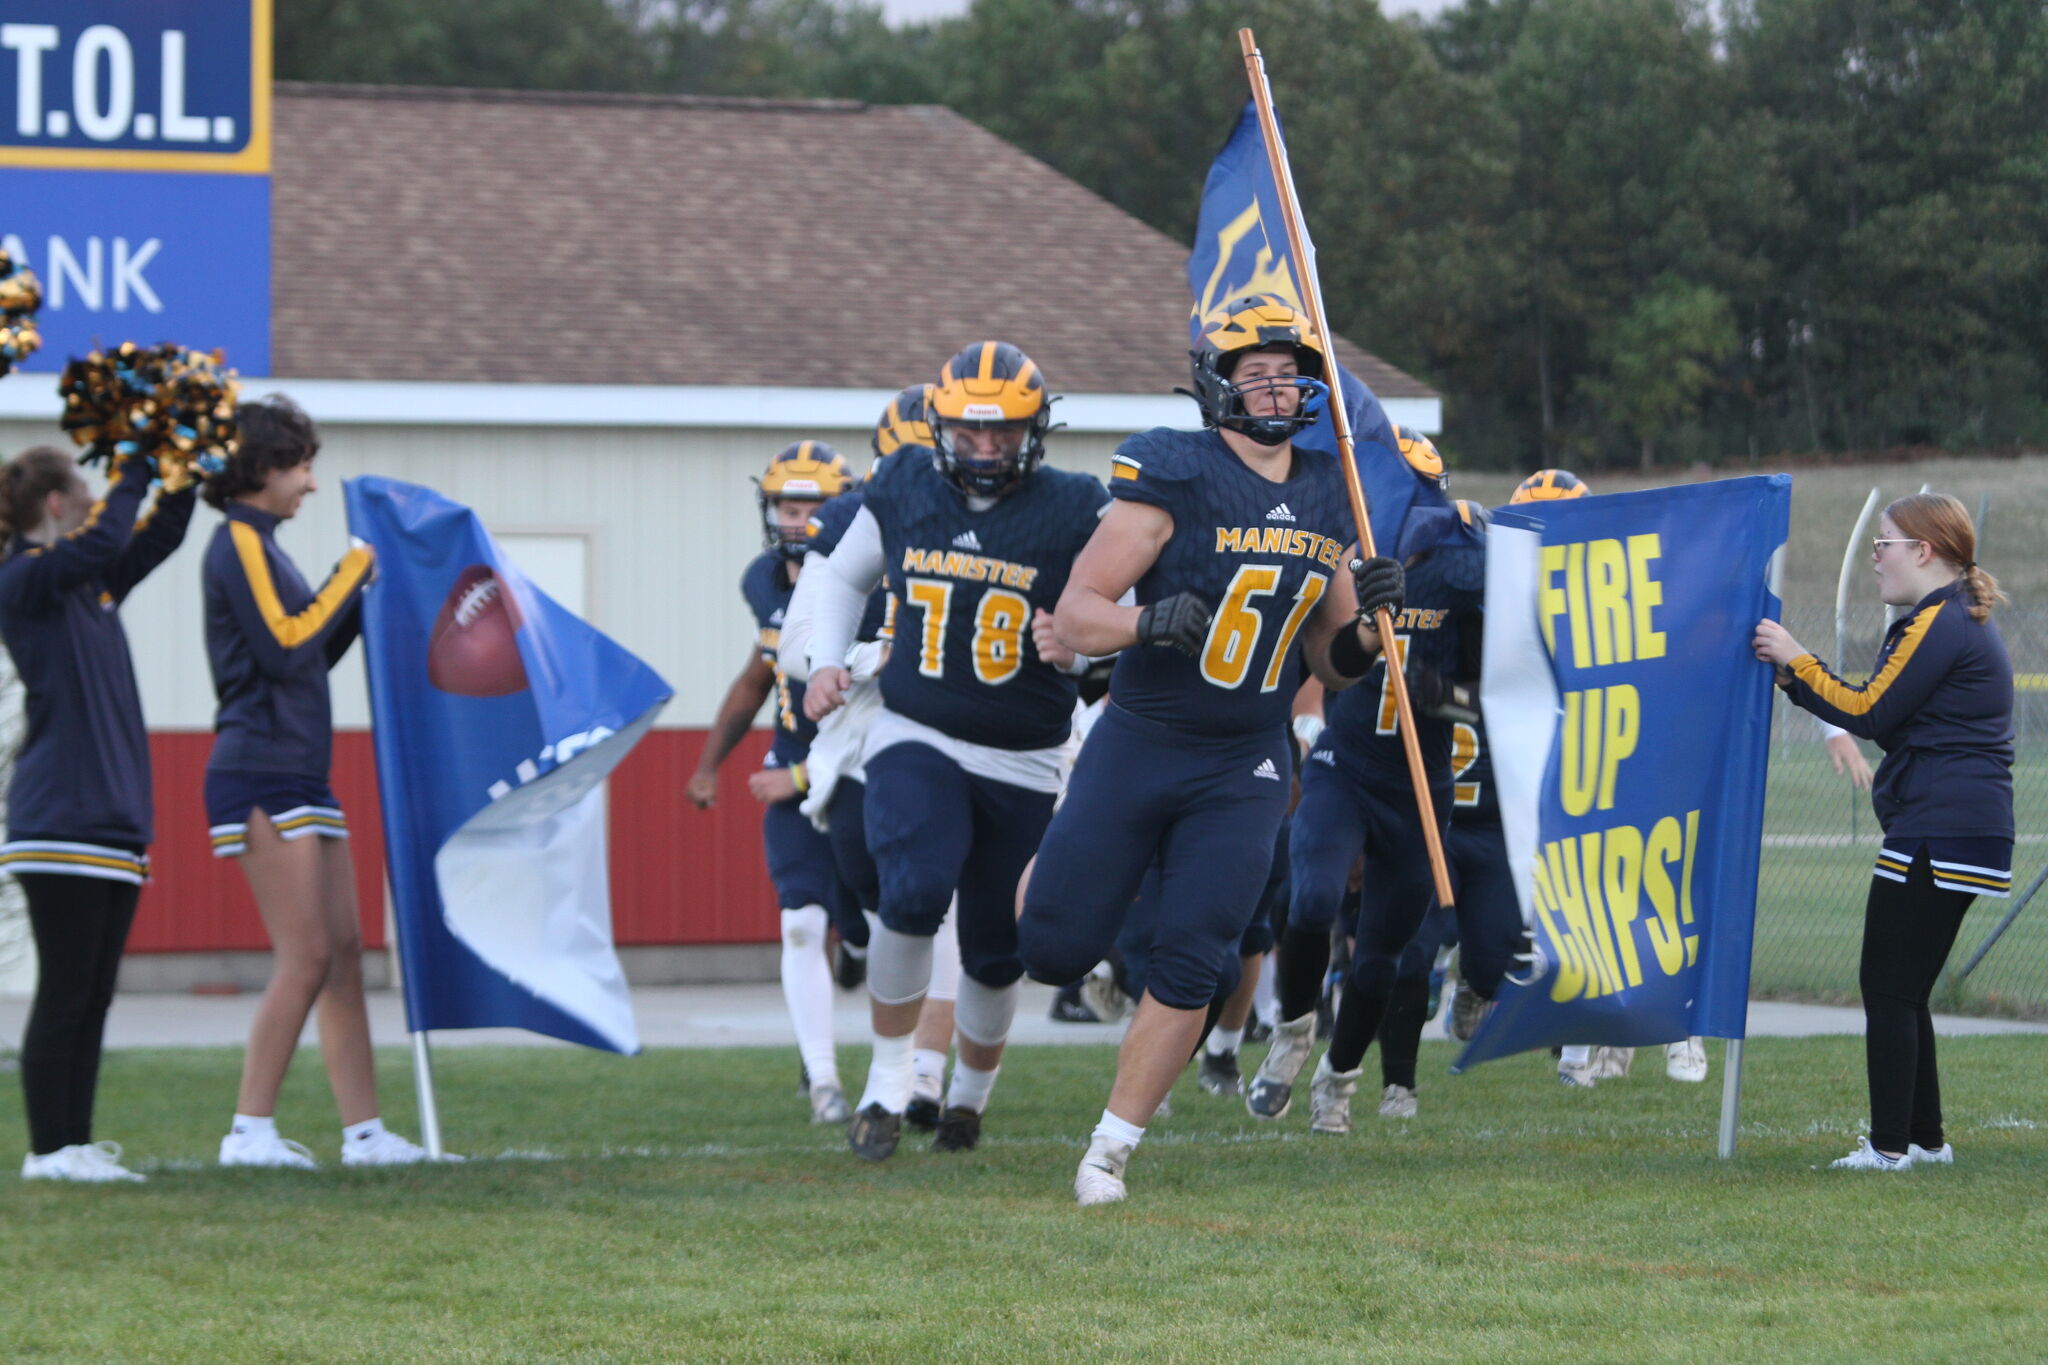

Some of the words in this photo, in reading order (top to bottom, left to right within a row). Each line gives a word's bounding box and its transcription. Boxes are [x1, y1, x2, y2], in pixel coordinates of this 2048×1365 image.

[1, 23, 236, 143] T.O.L.
[902, 546, 1038, 591] MANISTEE
[1215, 526, 1344, 571] MANISTEE
[1265, 512, 1297, 522] adidas
[906, 577, 1031, 686] 78
[1199, 563, 1329, 694] 61
[1537, 532, 1667, 669] FIRE
[1560, 684, 1641, 817] UP
[1532, 809, 1700, 1004] CHIPS!
